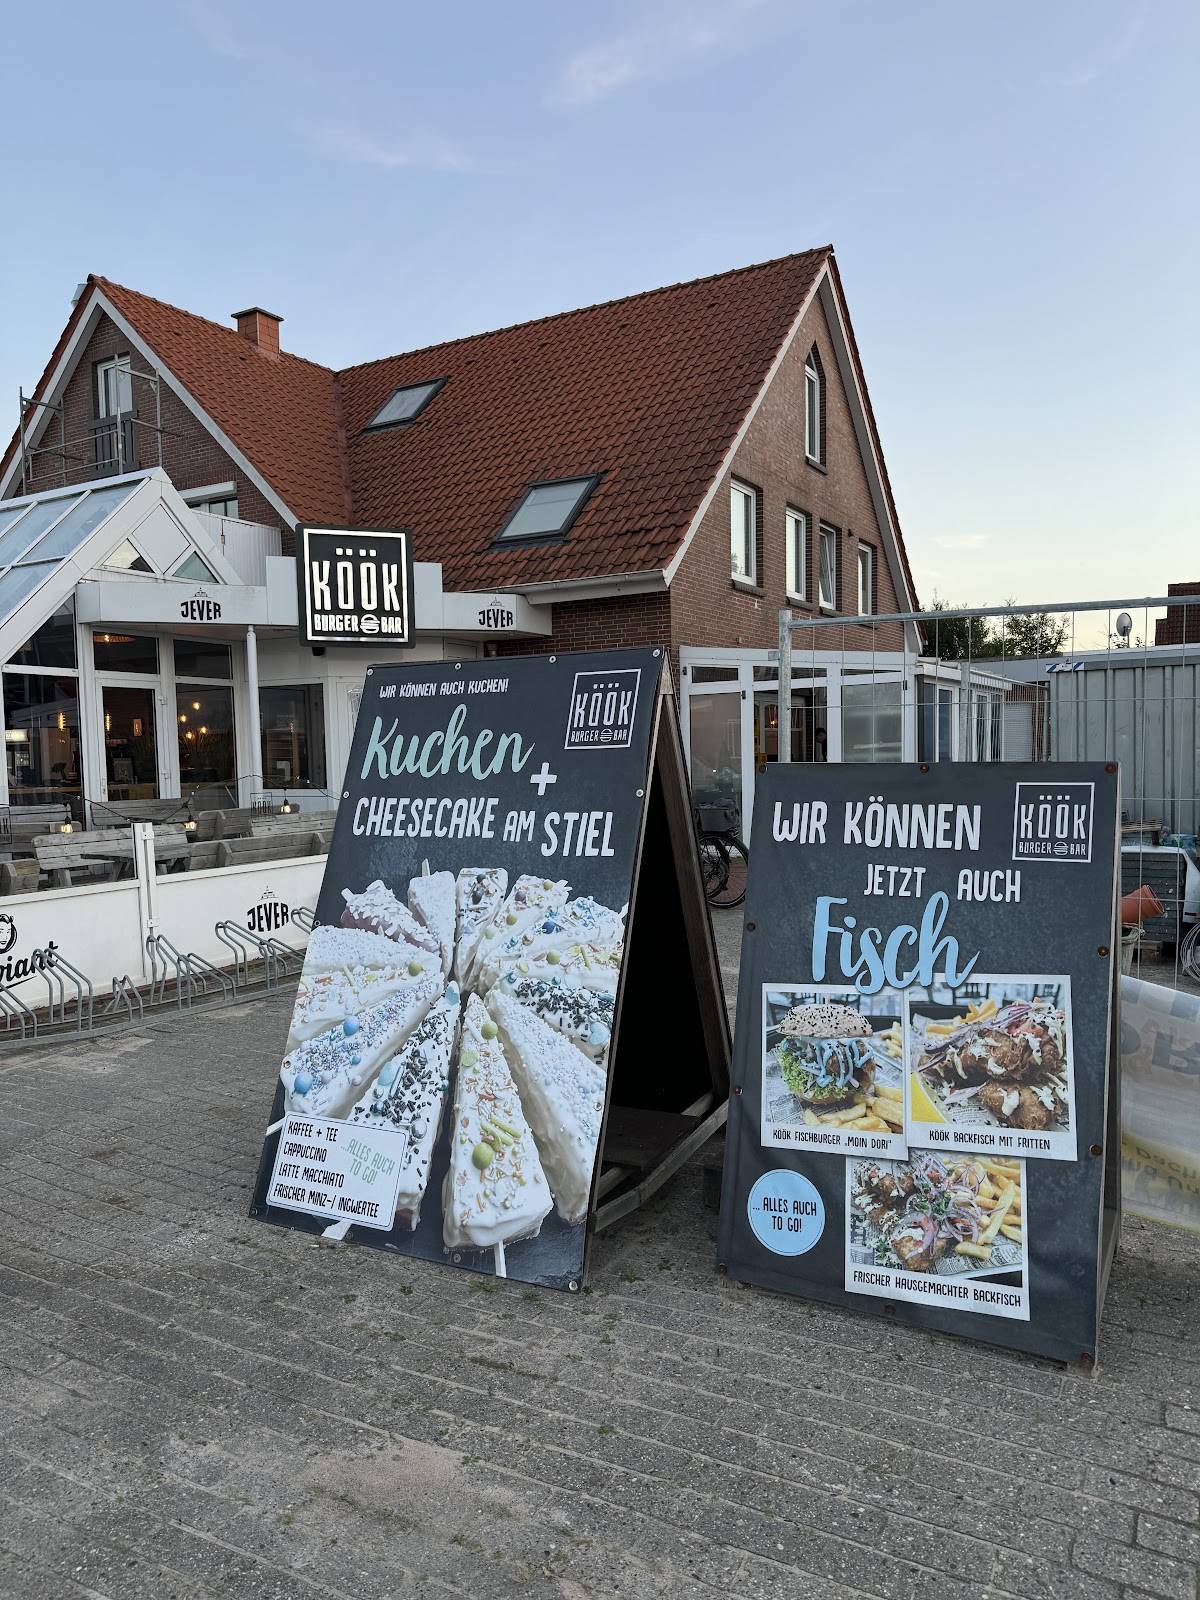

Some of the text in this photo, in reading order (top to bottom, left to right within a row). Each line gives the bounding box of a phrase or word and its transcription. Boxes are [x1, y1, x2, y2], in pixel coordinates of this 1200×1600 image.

[312, 547, 401, 612] KÖÖK
[181, 600, 221, 621] JEVER
[478, 608, 513, 628] JEVER
[314, 613, 402, 634] BURGER BAR
[379, 678, 509, 698] WIR KÖNNEN AUCH KUCHEN!
[573, 682, 633, 728] KÖÖK
[360, 703, 535, 780] Kuchen
[571, 729, 628, 742] BURGER BAR
[352, 797, 615, 857] CHEESECAKE AM STIEL
[773, 795, 981, 851] WIR KÖNNEN
[1020, 795, 1087, 839] KÖÖK
[1019, 841, 1086, 855] BURGER BAR
[863, 863, 1021, 903] JETZT AUCH
[247, 902, 289, 932] JEVER
[812, 890, 980, 995] Fisch
[287, 1121, 313, 1138] KAFFEE
[325, 1127, 339, 1142] TEE
[773, 1129, 791, 1140] KÖÖK
[794, 1131, 841, 1145] FISCHBURGER
[929, 1129, 1050, 1150] KÖÖK BACKFISCH MIT FRITTEN
[283, 1141, 328, 1163] CAPPUCCINO
[371, 1152, 395, 1176] AUCH
[278, 1162, 345, 1188] LATTE MACCHIATO
[350, 1159, 378, 1185] TO GO!
[273, 1183, 306, 1203] FRISCHER
[337, 1196, 380, 1218] INGWERTEE
[793, 1200, 817, 1216] AUCH
[772, 1215, 802, 1233] TO GO!
[853, 1270, 1021, 1307] FRISCHER HAUSGEMACHTER BACKFISCH
